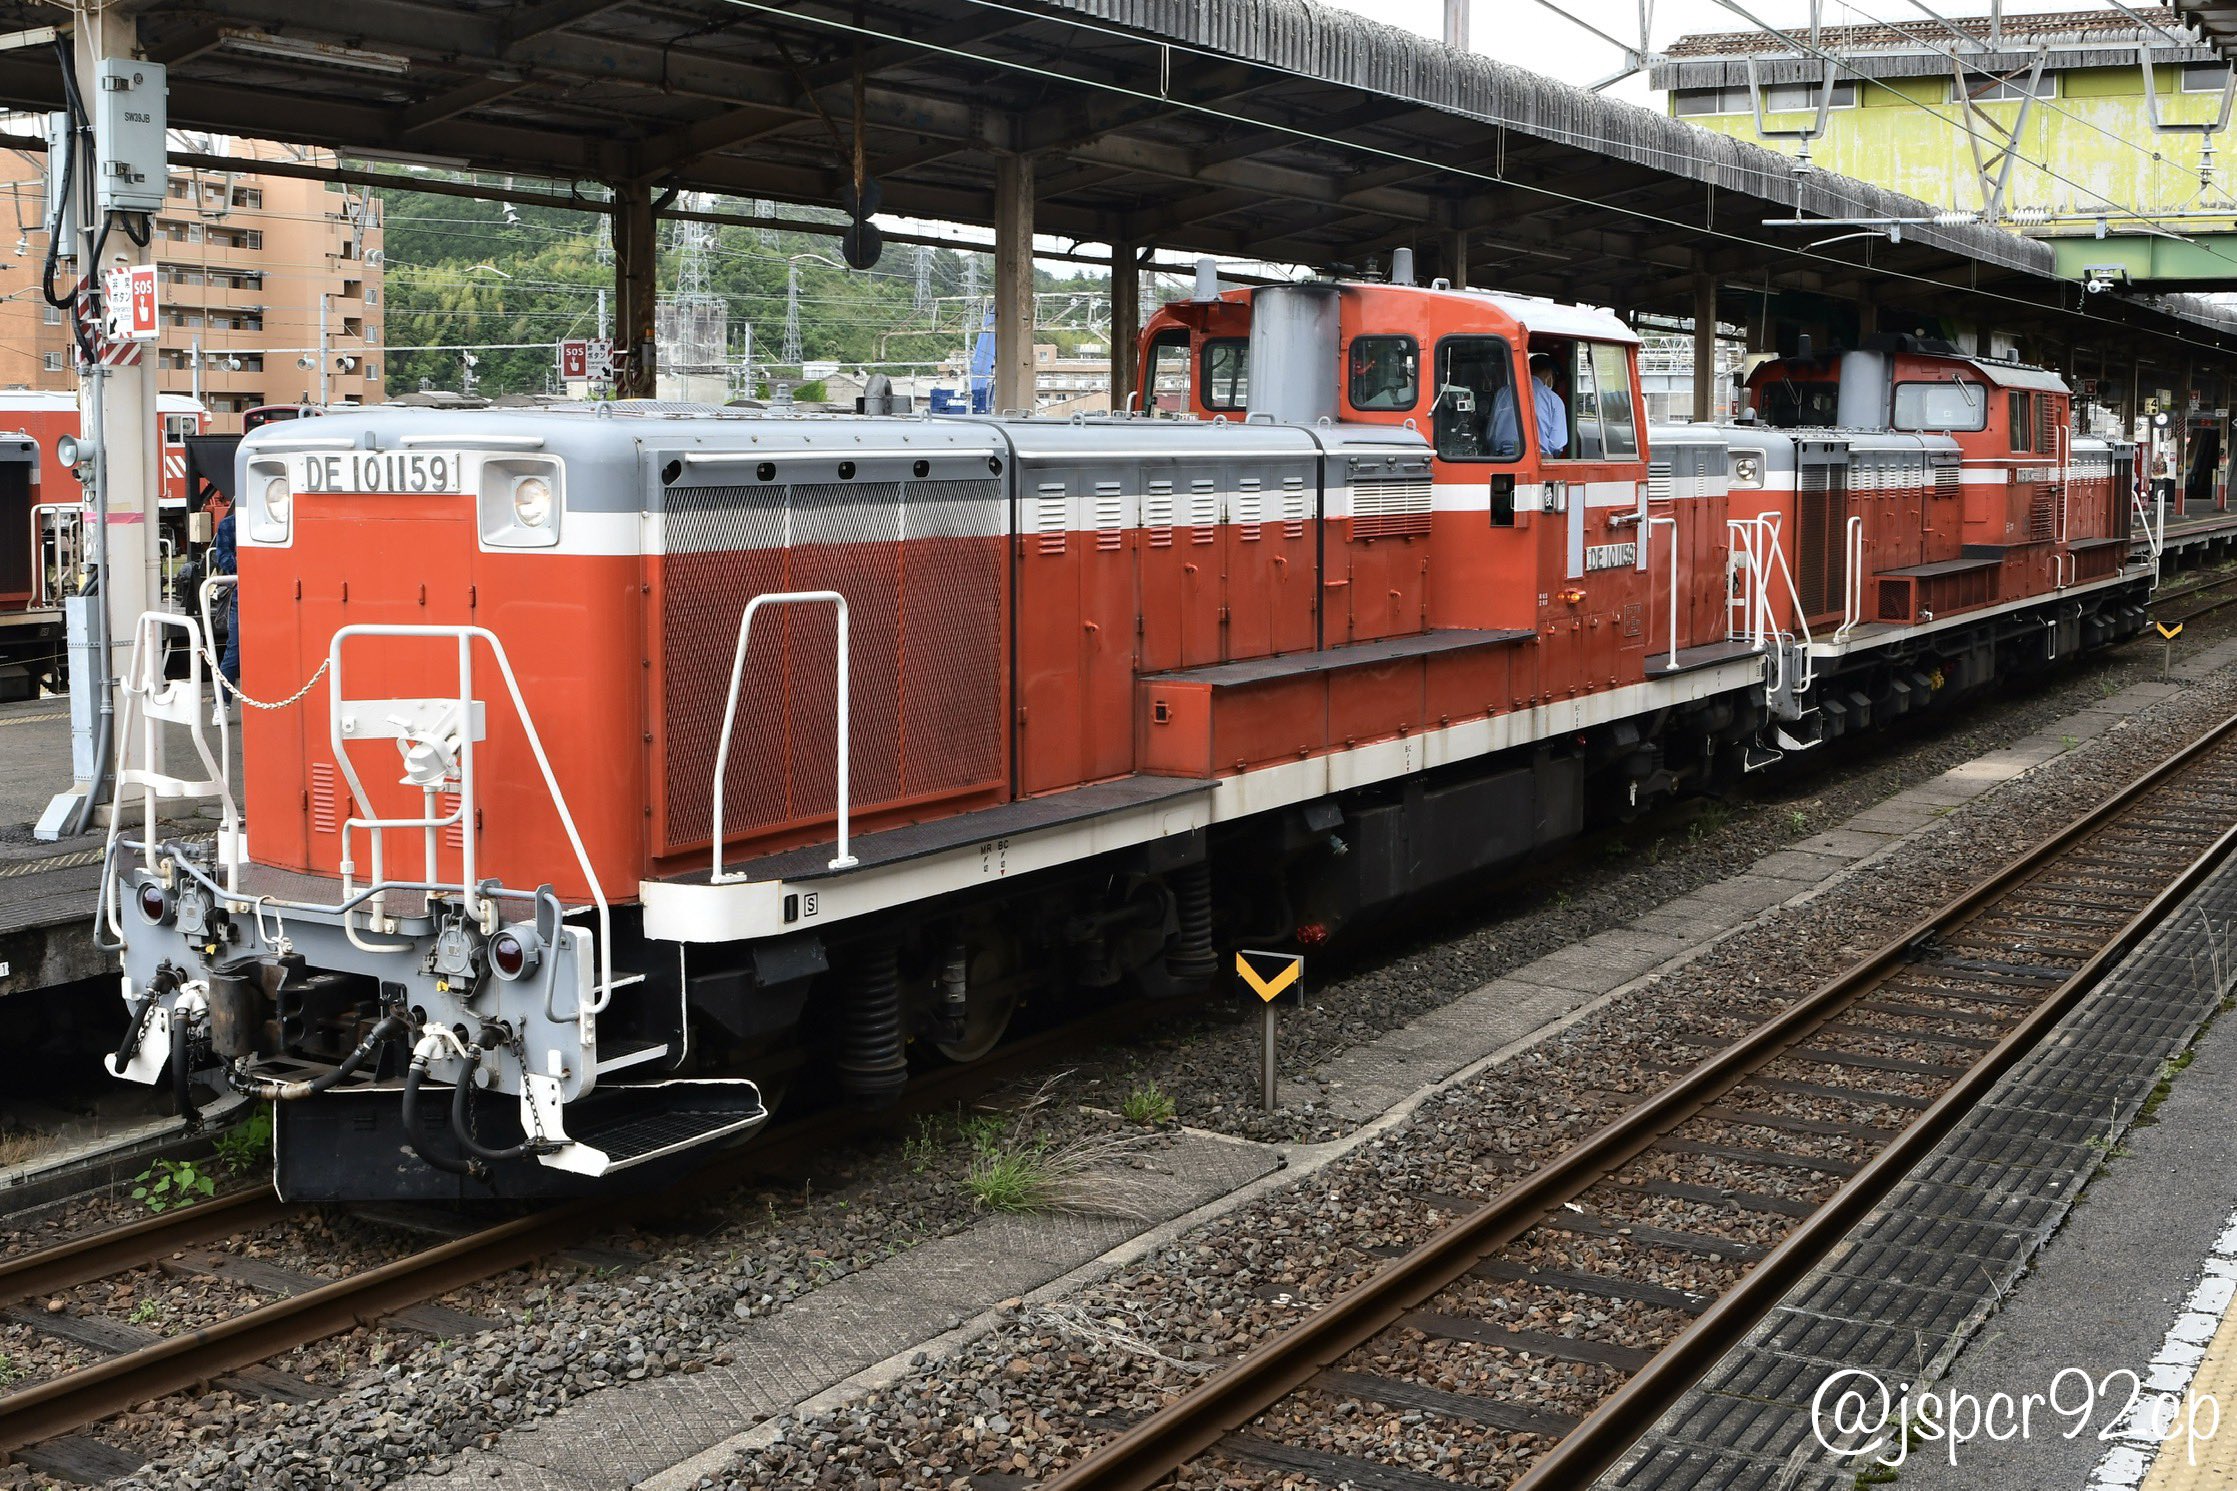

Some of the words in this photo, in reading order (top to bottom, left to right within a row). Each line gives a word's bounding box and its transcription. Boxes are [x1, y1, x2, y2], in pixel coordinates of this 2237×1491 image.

[134, 279, 153, 296] SOS
[112, 291, 131, 303] ボタン
[565, 347, 584, 356] SOS
[2150, 399, 2158, 408] 4
[306, 456, 343, 492] DE
[353, 455, 448, 493] 101159
[1590, 548, 1603, 569] DE
[980, 843, 992, 855] MR
[998, 840, 1009, 850] BC
[807, 897, 815, 912] S
